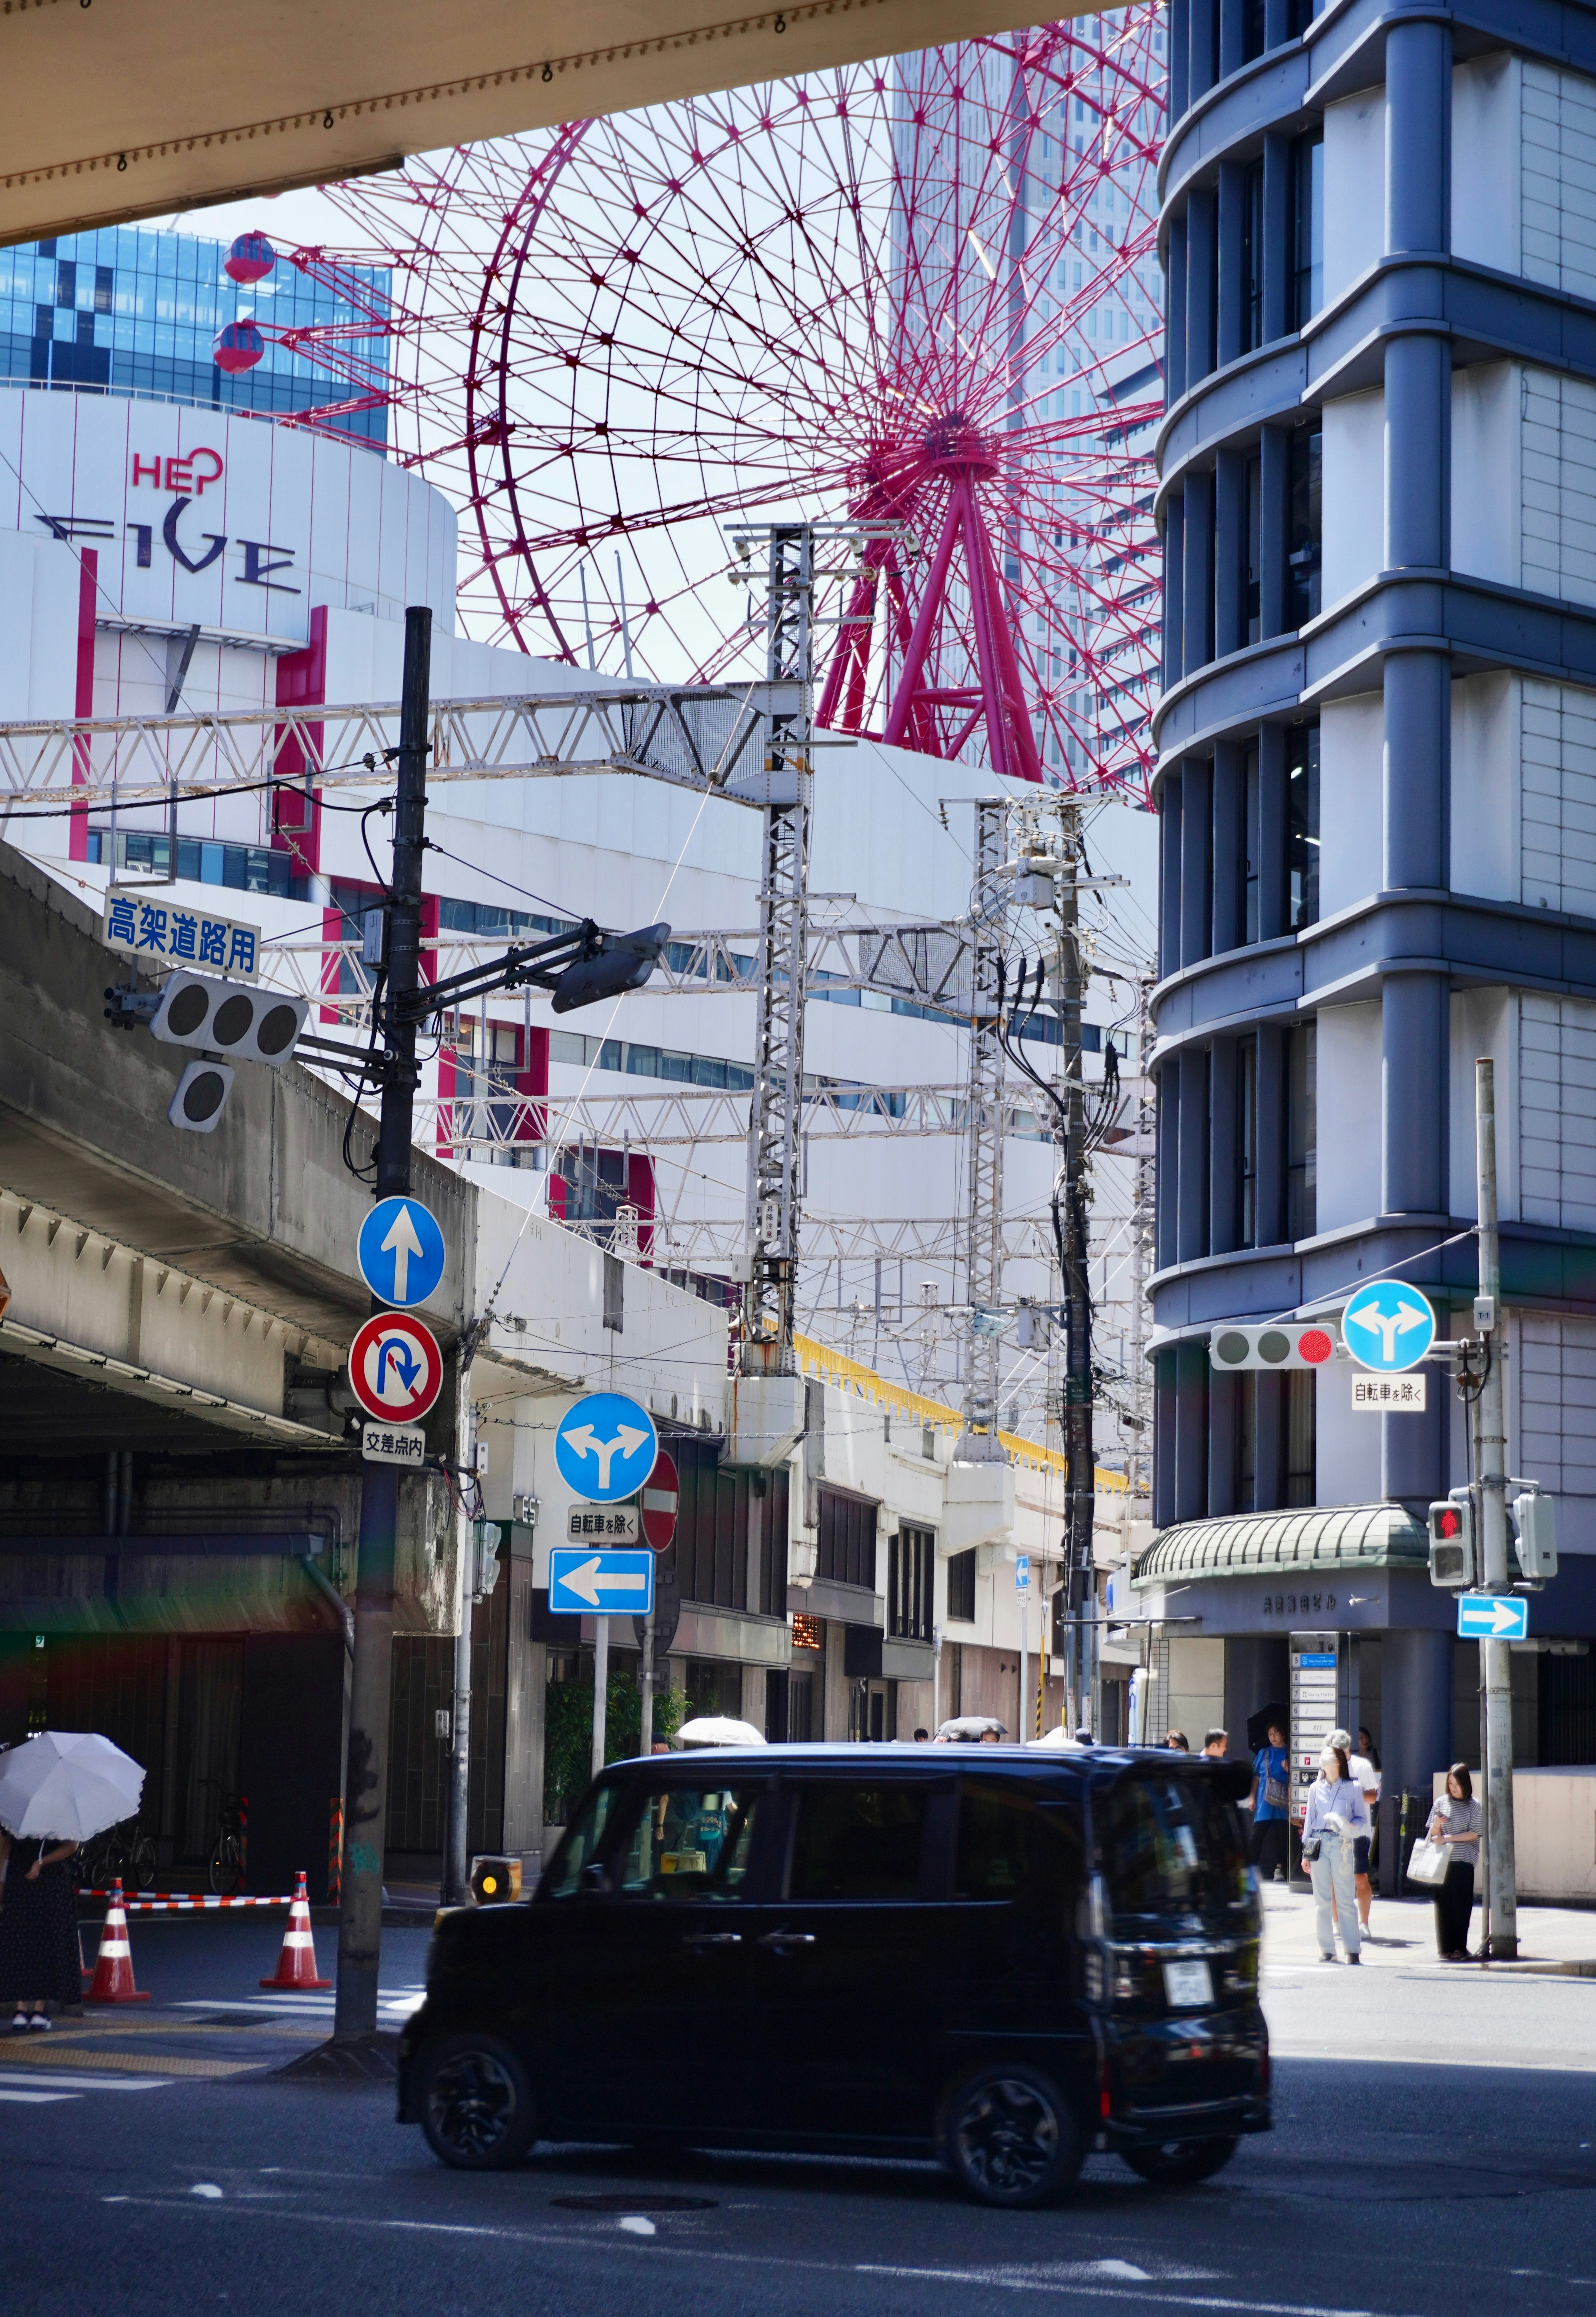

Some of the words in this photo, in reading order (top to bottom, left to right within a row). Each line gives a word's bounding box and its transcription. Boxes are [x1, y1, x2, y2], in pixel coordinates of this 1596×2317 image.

[133, 447, 223, 495] HEP
[34, 497, 301, 594] FIVE
[107, 897, 255, 974] 高架道路用
[1356, 1383, 1421, 1402] 自転車を除く
[366, 1431, 422, 1457] 交差点内
[522, 1495, 542, 1525] EST
[570, 1514, 634, 1535] 自転車を除く
